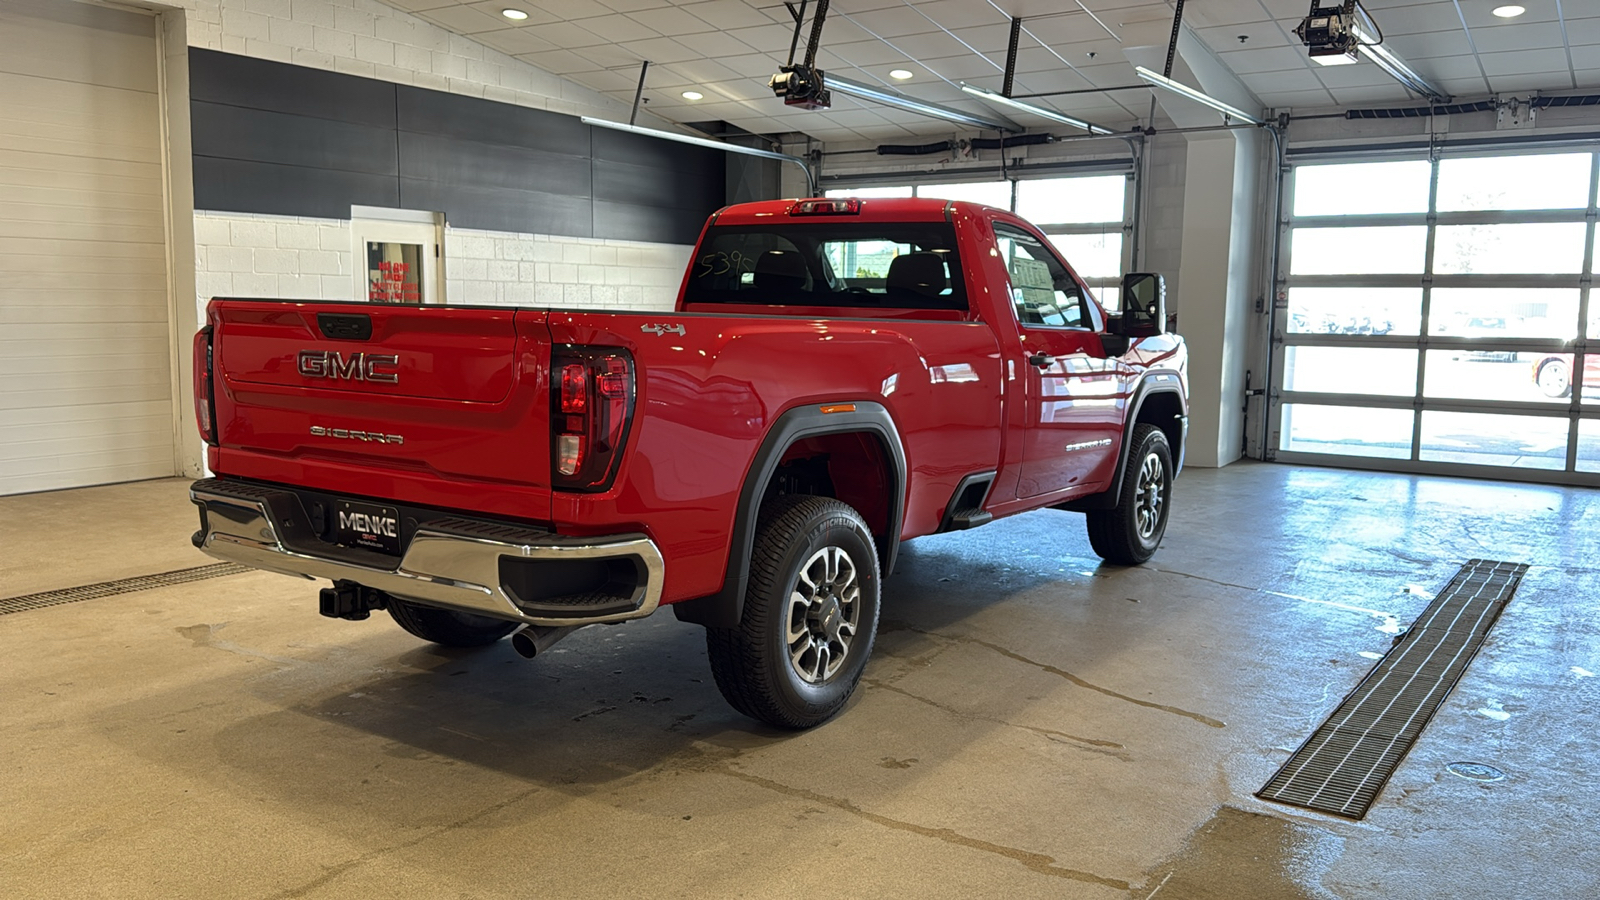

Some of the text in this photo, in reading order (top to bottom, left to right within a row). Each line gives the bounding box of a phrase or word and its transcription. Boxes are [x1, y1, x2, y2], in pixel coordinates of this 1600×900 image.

[297, 350, 399, 383] GMC
[310, 425, 404, 445] SIERRA
[339, 510, 397, 538] MENKE
[819, 517, 855, 533] MICHELIN
